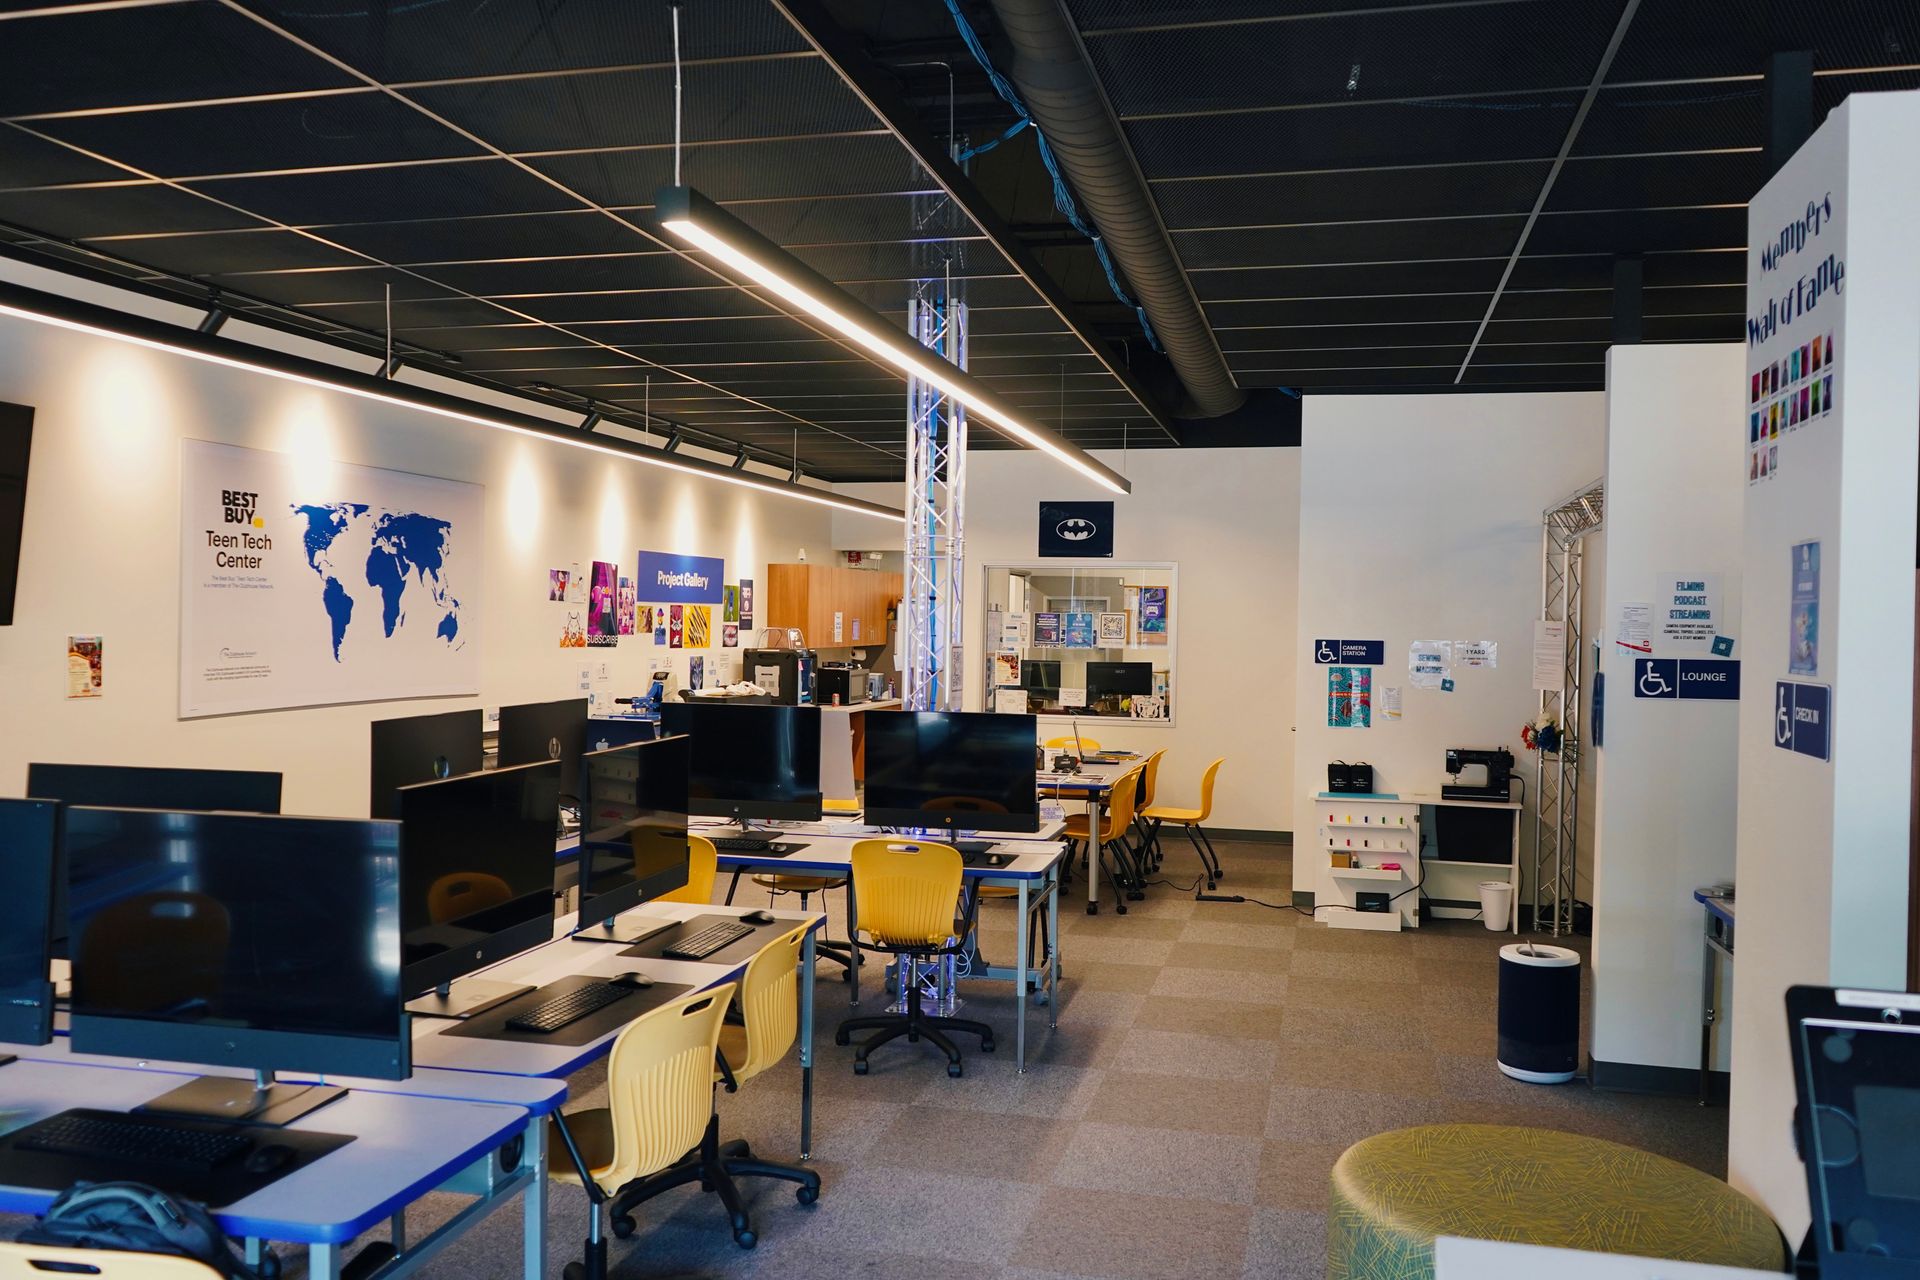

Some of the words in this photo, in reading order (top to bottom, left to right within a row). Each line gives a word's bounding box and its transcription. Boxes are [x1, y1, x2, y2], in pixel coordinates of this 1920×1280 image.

[1748, 298, 1777, 349] Wall
[1781, 287, 1794, 325] of
[1797, 253, 1845, 317] Fame
[222, 490, 258, 508] BEST
[224, 507, 255, 525] BUY
[206, 530, 239, 548] Teen
[241, 532, 272, 550] Tech
[216, 551, 262, 569] Center
[657, 570, 684, 588] Project
[684, 572, 709, 591] Gallery
[1676, 582, 1705, 591] FILMING
[1674, 595, 1707, 605] PODCAST
[1669, 609, 1711, 619] STREAMING
[587, 634, 618, 645] SUBSCRIBE
[1682, 672, 1726, 681] LOUNGE
[1795, 707, 1812, 722] CHECK
[1812, 710, 1819, 724] IN
